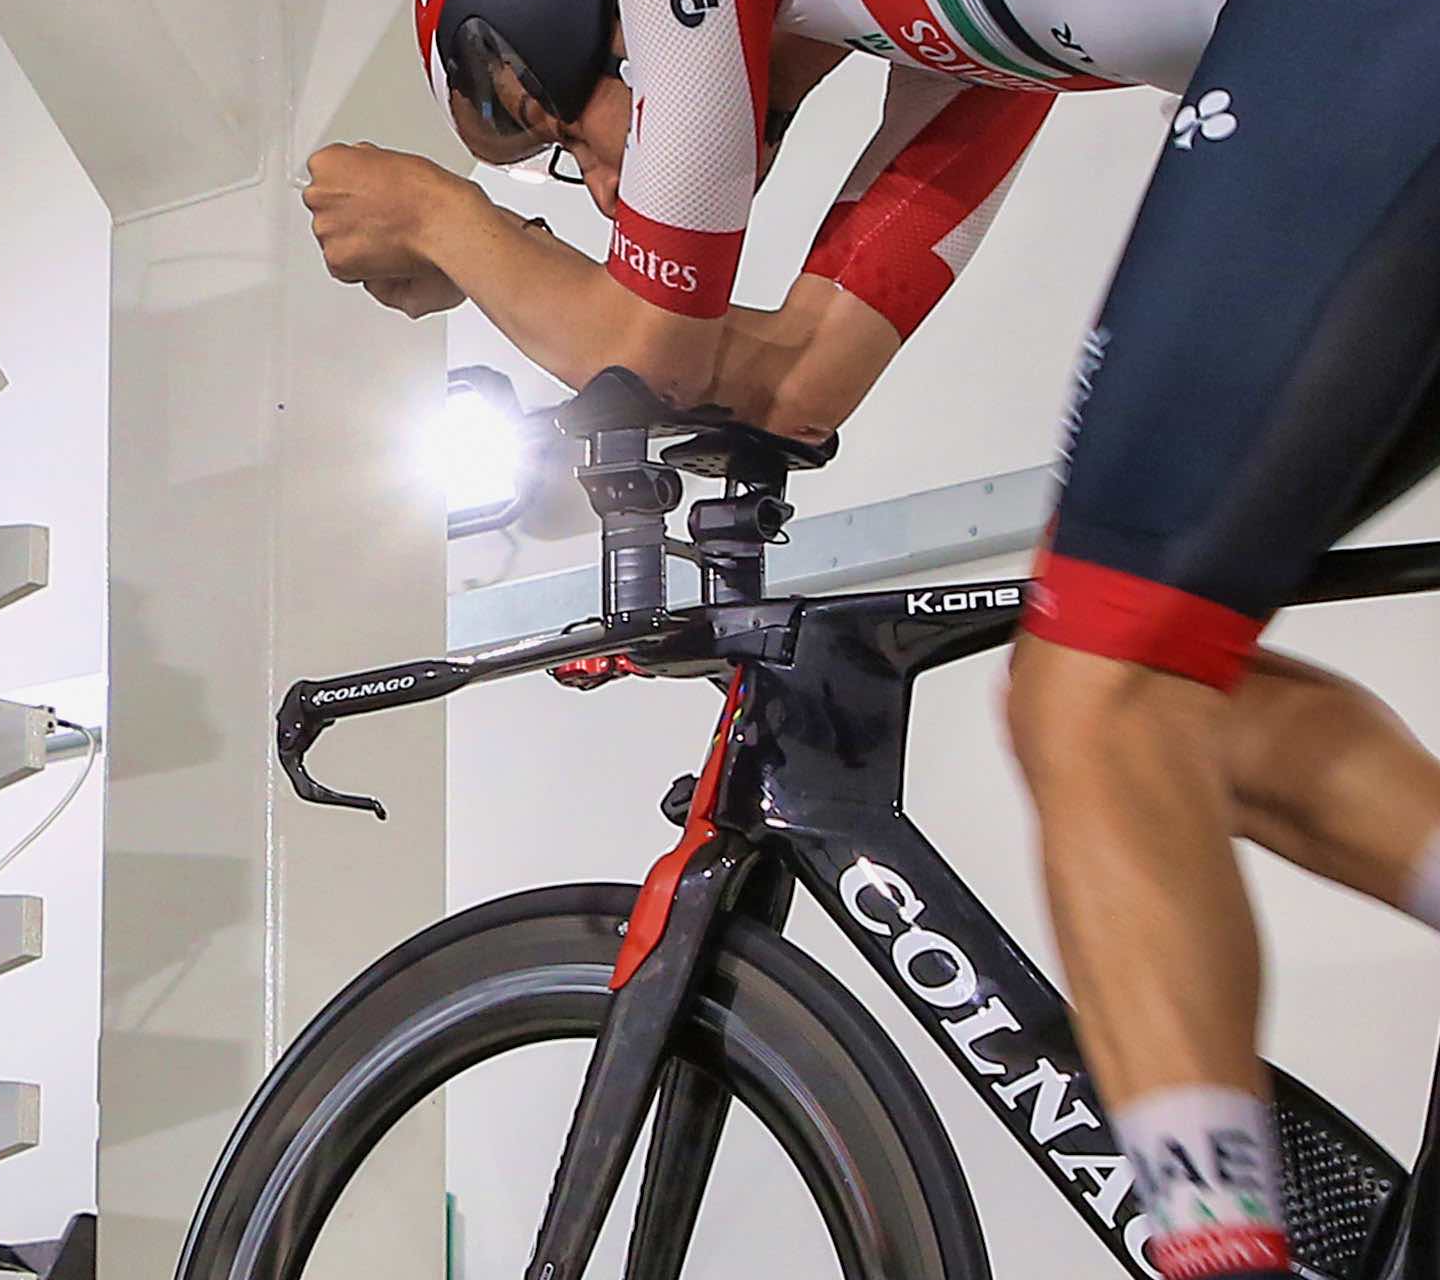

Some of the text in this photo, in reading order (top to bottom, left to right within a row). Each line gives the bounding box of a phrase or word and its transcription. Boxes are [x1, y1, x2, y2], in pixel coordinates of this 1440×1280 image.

[614, 221, 697, 292] irates
[906, 587, 1020, 615] K.one
[323, 676, 416, 703] COLNAGO
